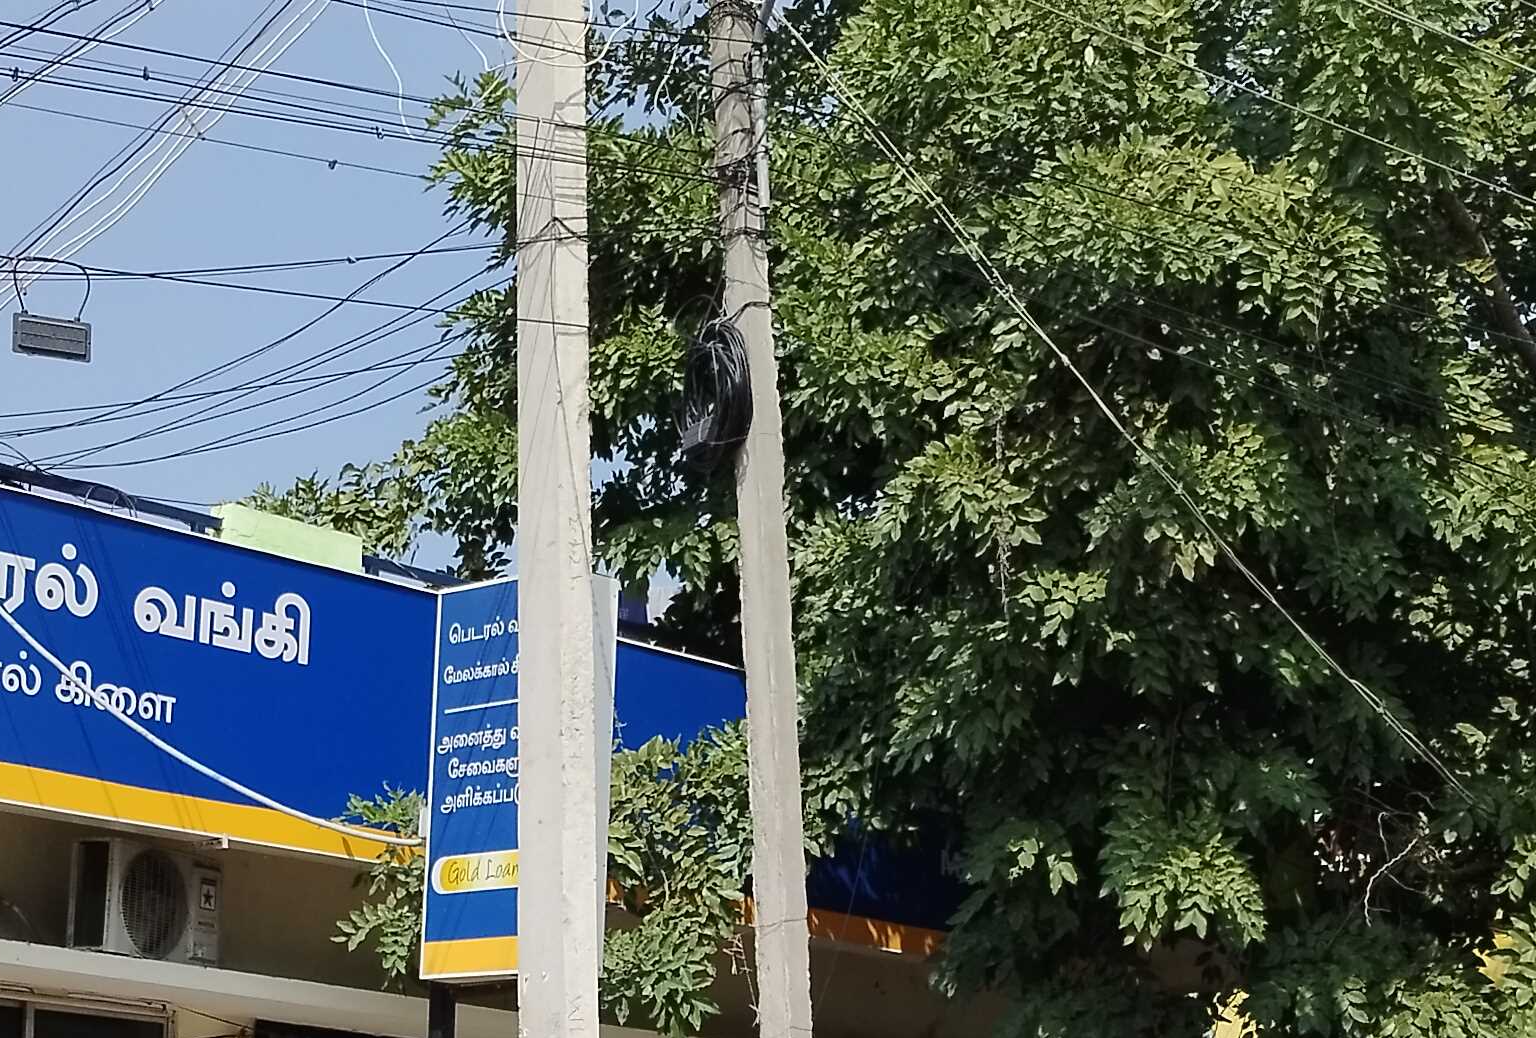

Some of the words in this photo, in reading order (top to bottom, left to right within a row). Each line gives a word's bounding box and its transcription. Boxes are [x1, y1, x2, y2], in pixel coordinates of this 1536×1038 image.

[134, 581, 311, 666] வங்கி
[449, 615, 505, 644] பெடரல்
[444, 657, 510, 684] மேலக்கால்
[55, 660, 177, 724] கிளை
[437, 723, 506, 754] அனைத்து
[448, 757, 520, 778] சேவைகளு
[441, 783, 520, 814] அளிக்கப்ப
[448, 859, 481, 885] Gold
